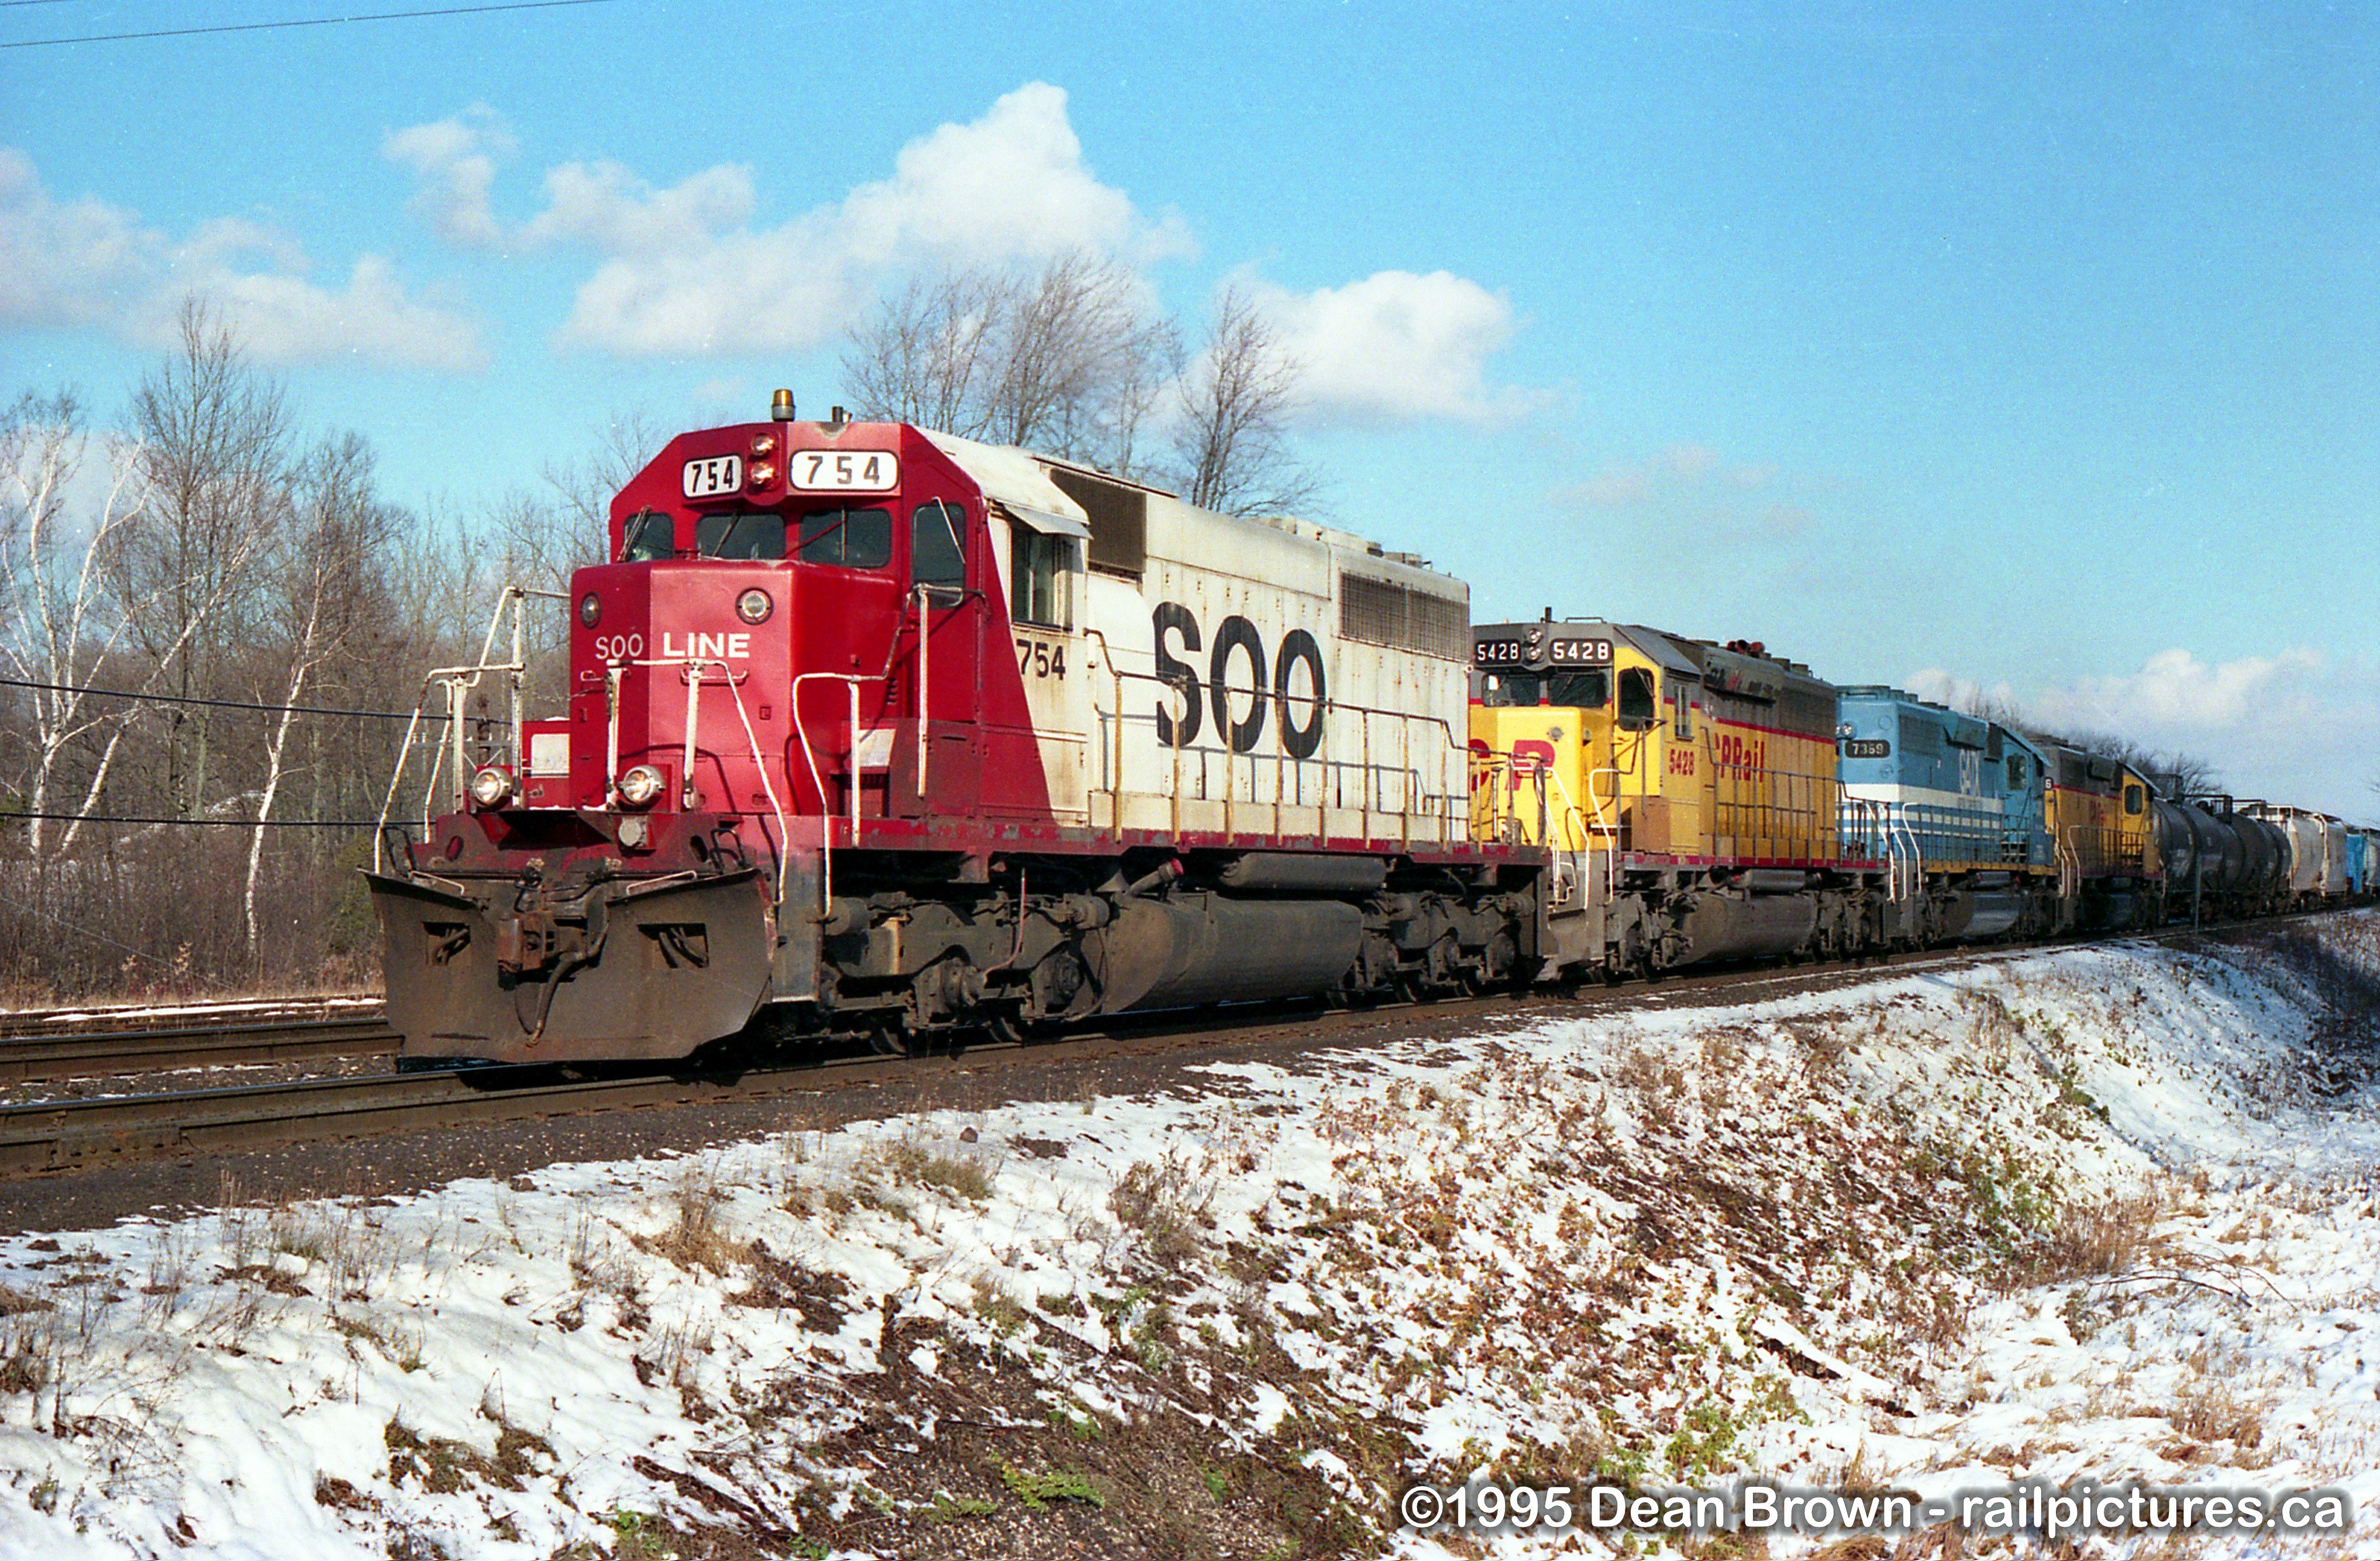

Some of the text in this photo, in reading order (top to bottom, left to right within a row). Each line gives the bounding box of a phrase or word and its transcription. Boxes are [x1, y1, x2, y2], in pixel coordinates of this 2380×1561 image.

[691, 460, 733, 493] 754
[807, 455, 880, 485] 754
[595, 632, 750, 660] SOO LINE
[1016, 638, 1066, 680] 754
[1477, 643, 1519, 661] 5428
[1553, 642, 1609, 660] 5428
[1152, 601, 1326, 759] SOO
[1669, 749, 1695, 777] 5428
